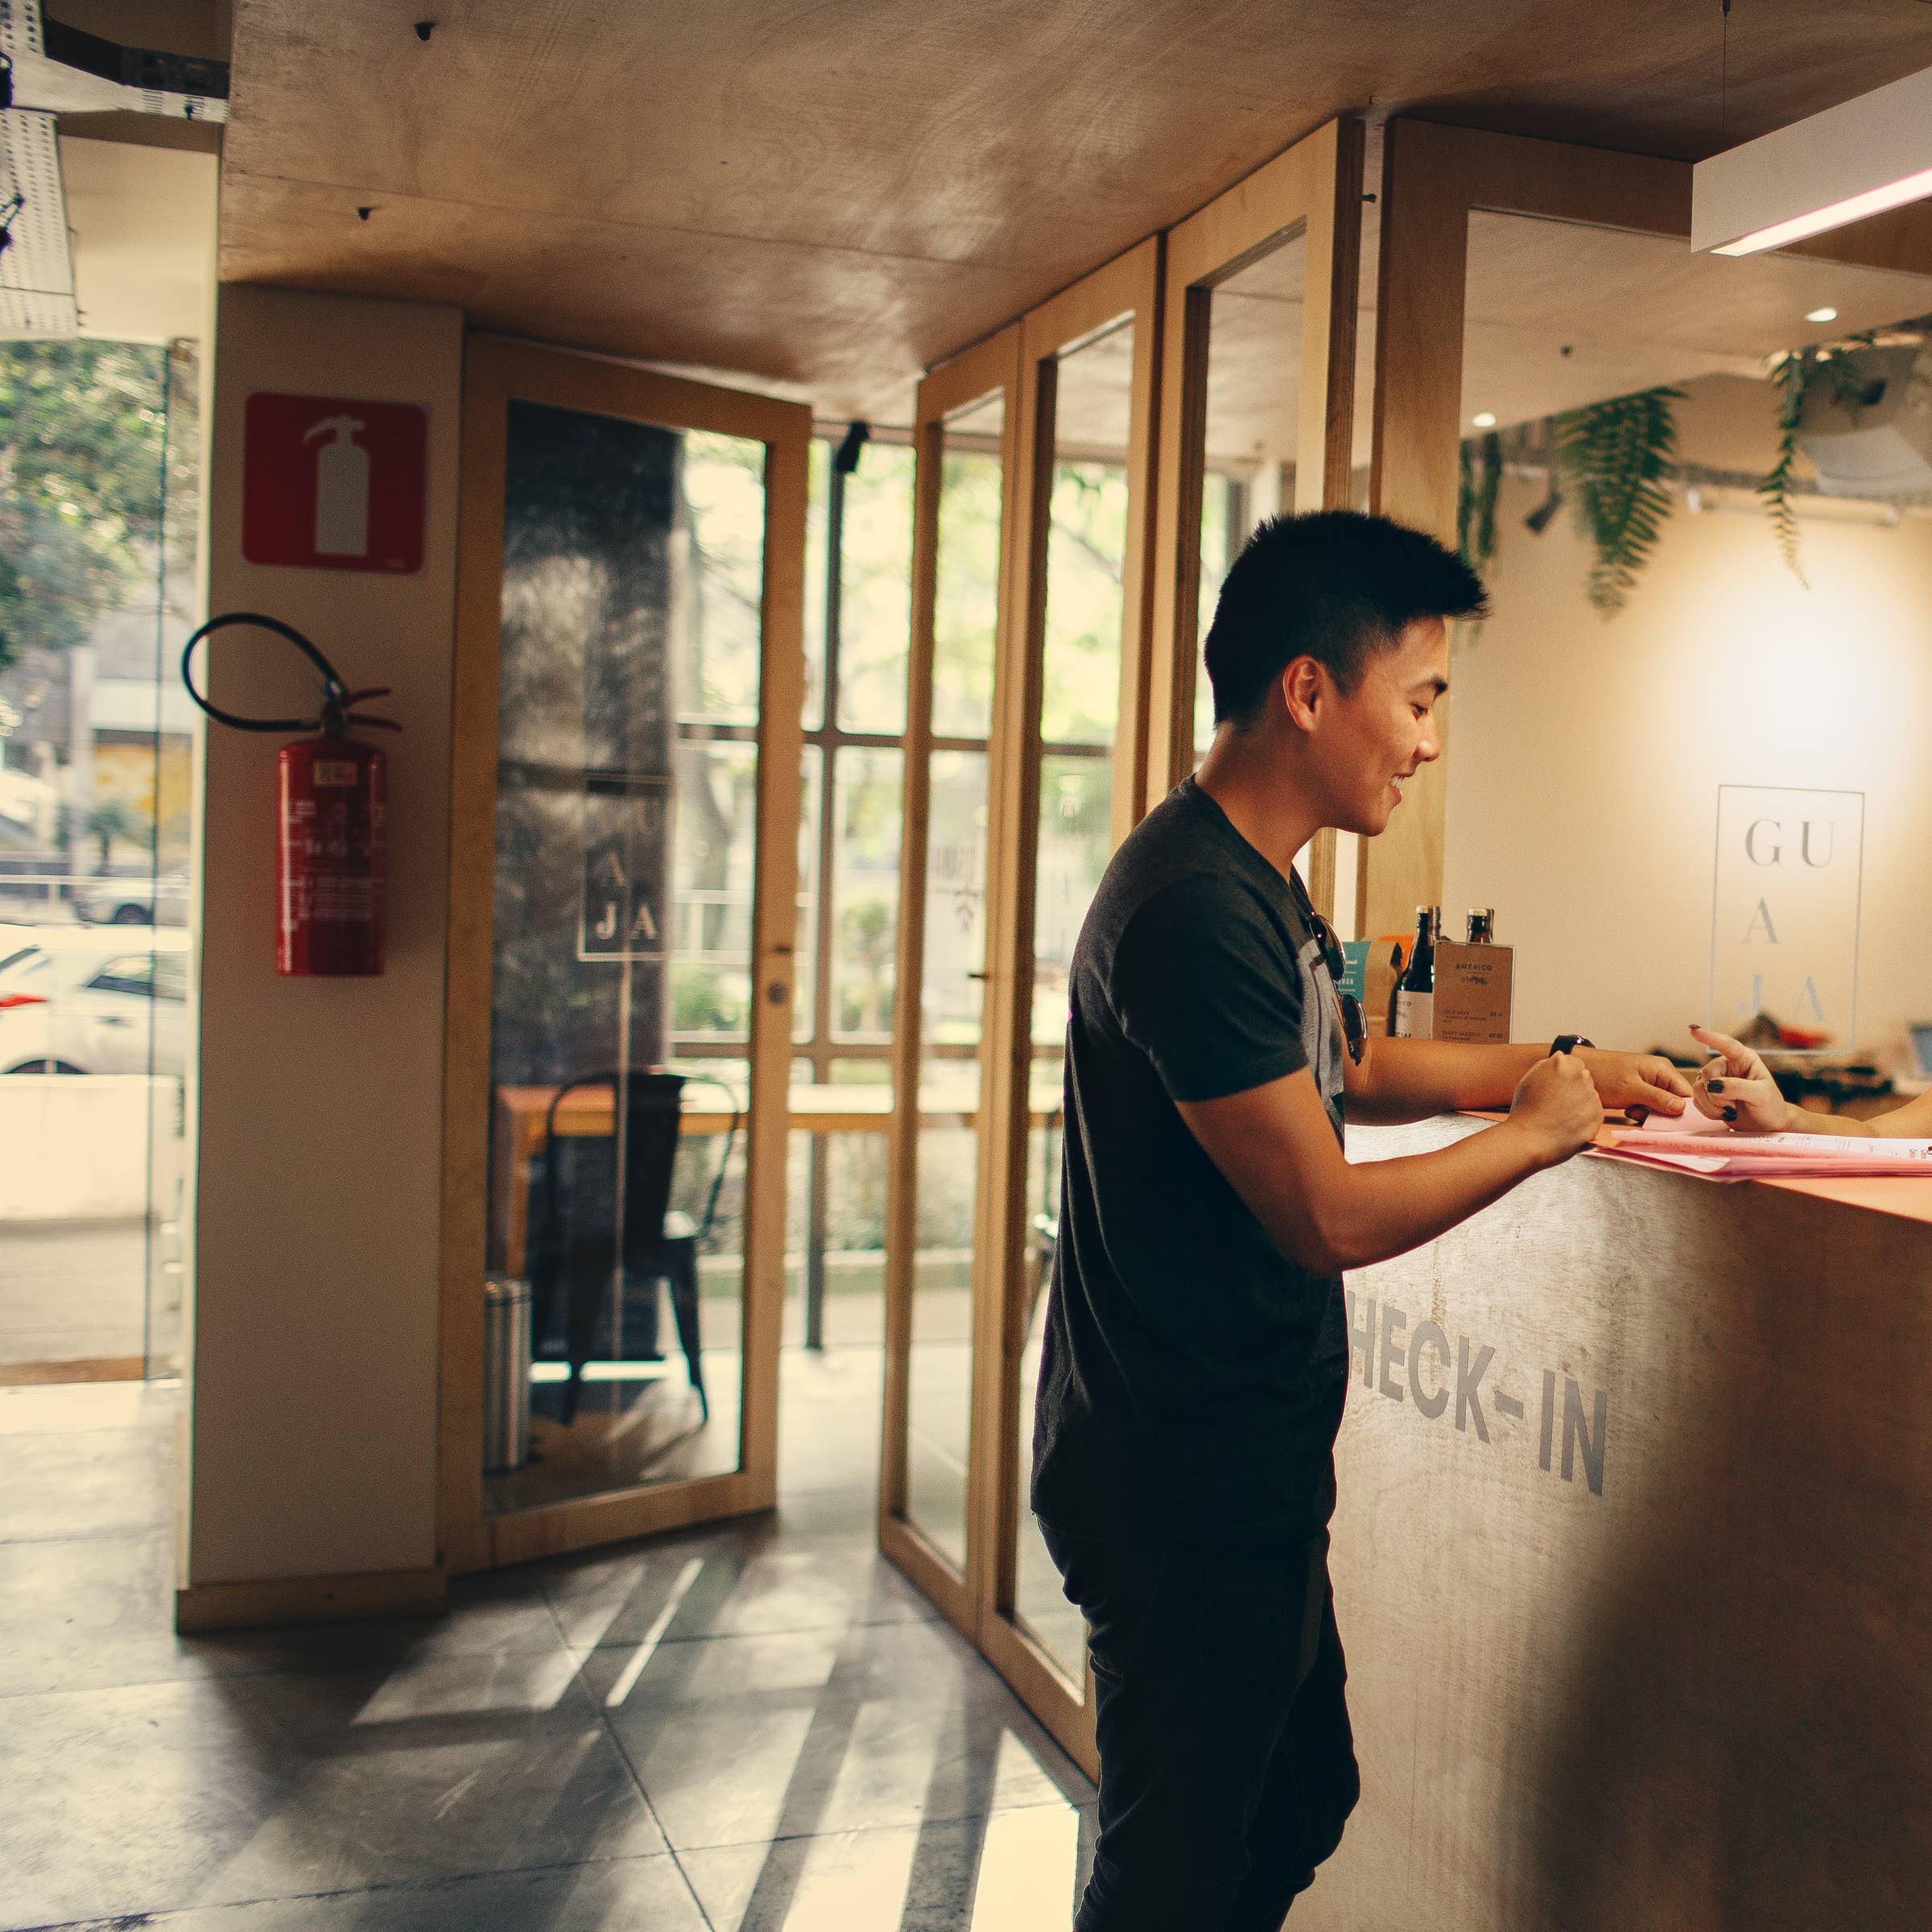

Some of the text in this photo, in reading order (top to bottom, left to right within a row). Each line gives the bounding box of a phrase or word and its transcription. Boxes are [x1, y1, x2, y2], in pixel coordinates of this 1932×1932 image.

[1744, 818, 1836, 869] GU
[595, 901, 656, 940] JA
[1741, 897, 1779, 944] A
[1345, 1290, 1608, 1497] HECK-IN
